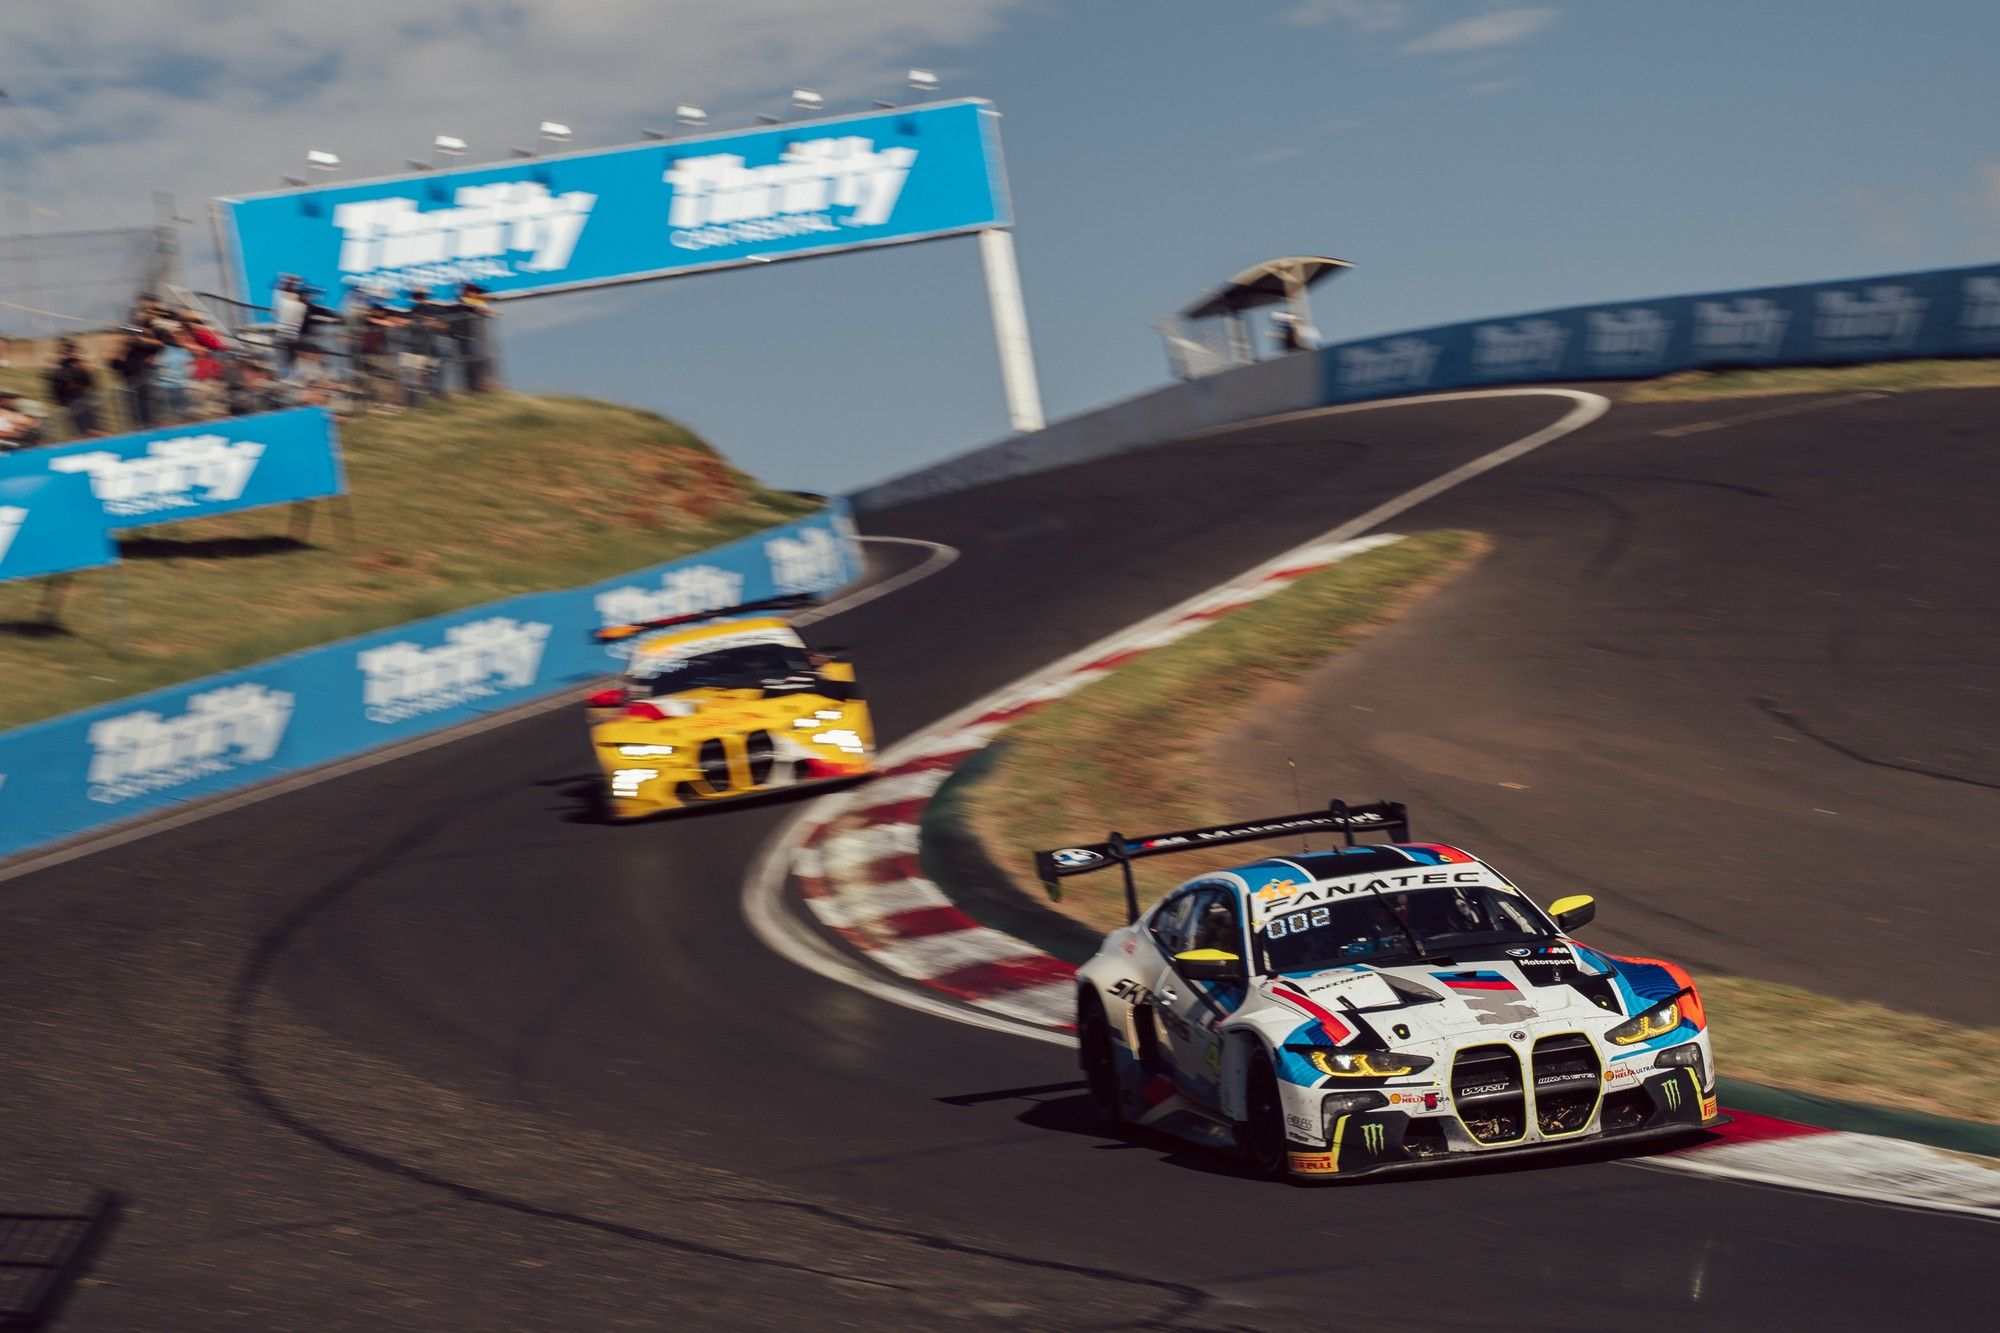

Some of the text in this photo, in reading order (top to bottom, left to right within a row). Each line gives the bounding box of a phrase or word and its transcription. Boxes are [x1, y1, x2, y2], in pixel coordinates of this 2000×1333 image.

[1257, 879, 1298, 901] 46
[1263, 872, 1480, 913] FANATEC
[1266, 907, 1331, 940] 002
[1290, 1155, 1332, 1170] PIRELLI
